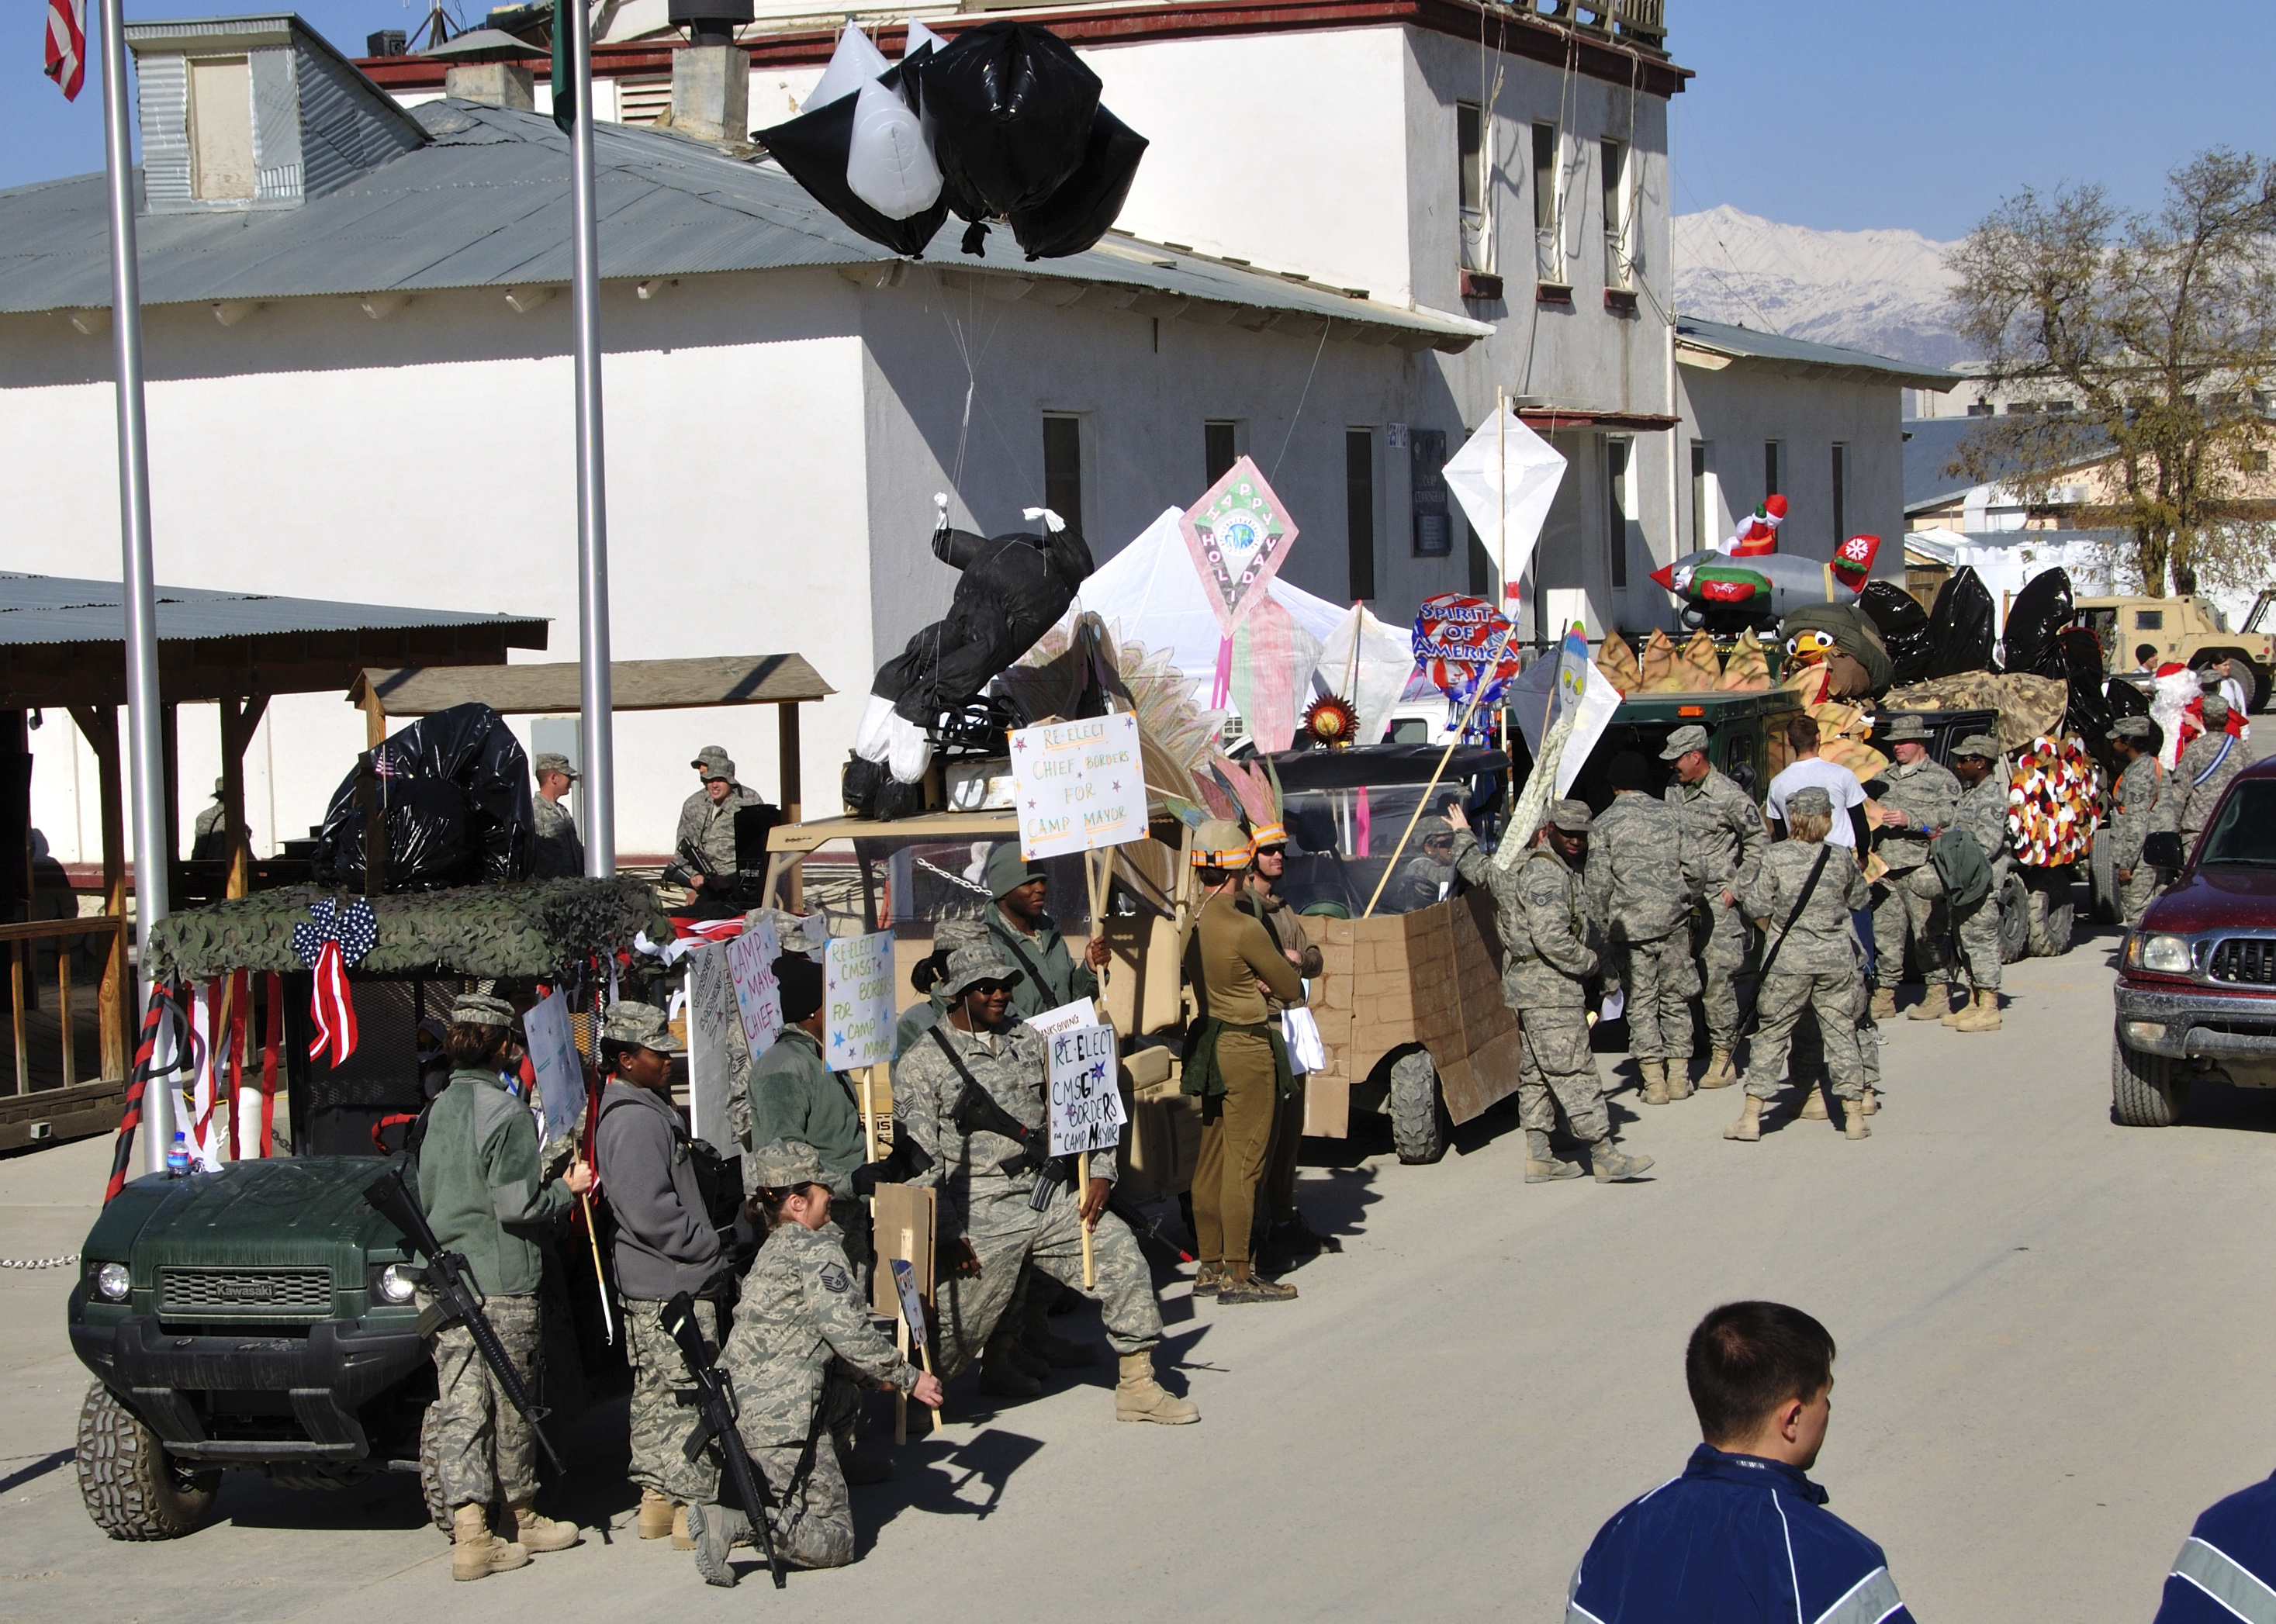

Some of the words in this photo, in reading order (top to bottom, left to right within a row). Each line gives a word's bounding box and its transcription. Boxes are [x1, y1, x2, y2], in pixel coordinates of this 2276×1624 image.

[1206, 482, 1274, 526] HAPPY
[1420, 602, 1493, 622] SPIRIT
[1444, 624, 1475, 641] OF
[1412, 638, 1518, 662] AMERICA
[1043, 723, 1105, 746] RE-ELECT
[1033, 758, 1075, 780] CHIEF
[1085, 751, 1129, 769] BORDERS
[1064, 783, 1095, 804] FOR
[1027, 816, 1071, 838] CAMP
[1084, 805, 1126, 827] MAYOR
[729, 931, 763, 984] CAMP
[832, 935, 876, 963] RE-ELECT
[842, 956, 877, 981] CMSGT
[747, 962, 775, 1001] MAYO
[745, 1002, 773, 1040] CHIEF
[833, 1001, 853, 1021] FOR
[847, 1018, 876, 1040] CAMP
[863, 1035, 893, 1059] MAYOR
[1069, 1093, 1117, 1128] BORDERS
[1088, 1122, 1118, 1149] MAYOR
[216, 1285, 273, 1297] Kawasaki
